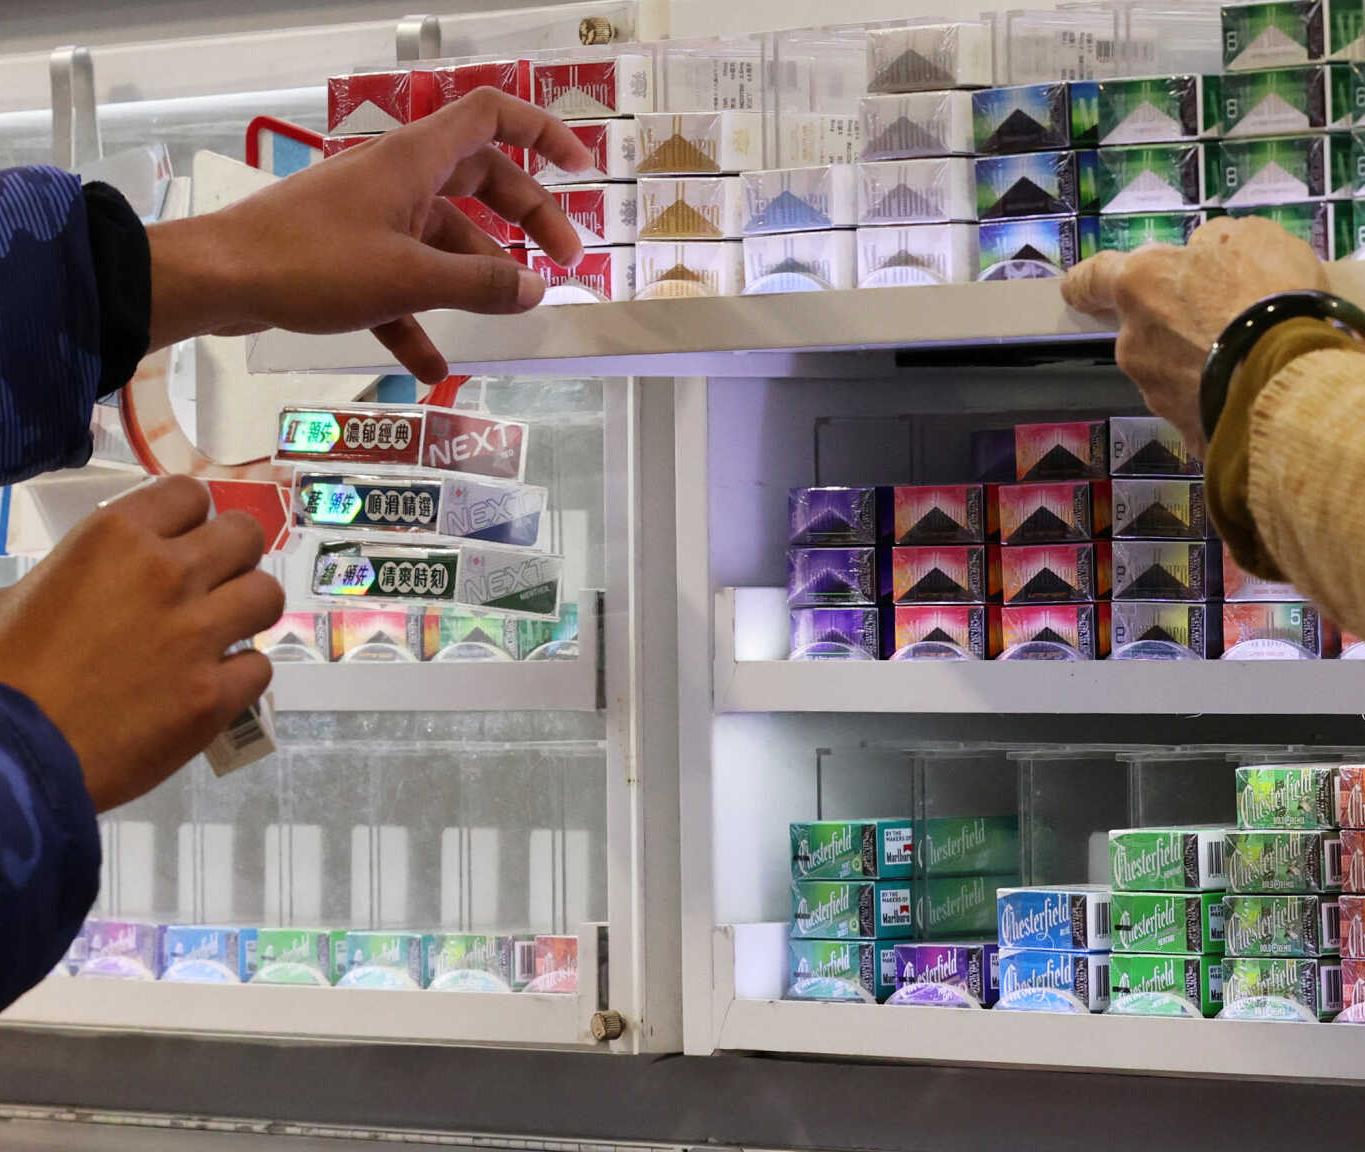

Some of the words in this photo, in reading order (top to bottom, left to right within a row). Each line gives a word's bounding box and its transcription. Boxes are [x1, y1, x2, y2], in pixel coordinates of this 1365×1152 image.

[345, 421, 410, 446] 濃郁經典
[429, 422, 509, 466] NEXT
[367, 490, 432, 518] 順滑精選
[381, 565, 446, 589] 清爽時刻
[466, 557, 548, 604] NEXT
[1290, 607, 1301, 626] 5
[1241, 768, 1312, 828] Chesterfield
[798, 825, 852, 876] Chesterfield
[1115, 832, 1181, 889] Chesterfield
[1230, 832, 1301, 890] Chesterfield
[797, 884, 850, 935] Chesterfield
[883, 909, 910, 923] Marlboro
[1002, 893, 1071, 946] Chesterfield
[1120, 896, 1175, 950] Chesterfield
[1228, 897, 1298, 956] Chesterfield
[898, 949, 958, 997] Chesterfield
[1001, 954, 1072, 1006] Chesterfield
